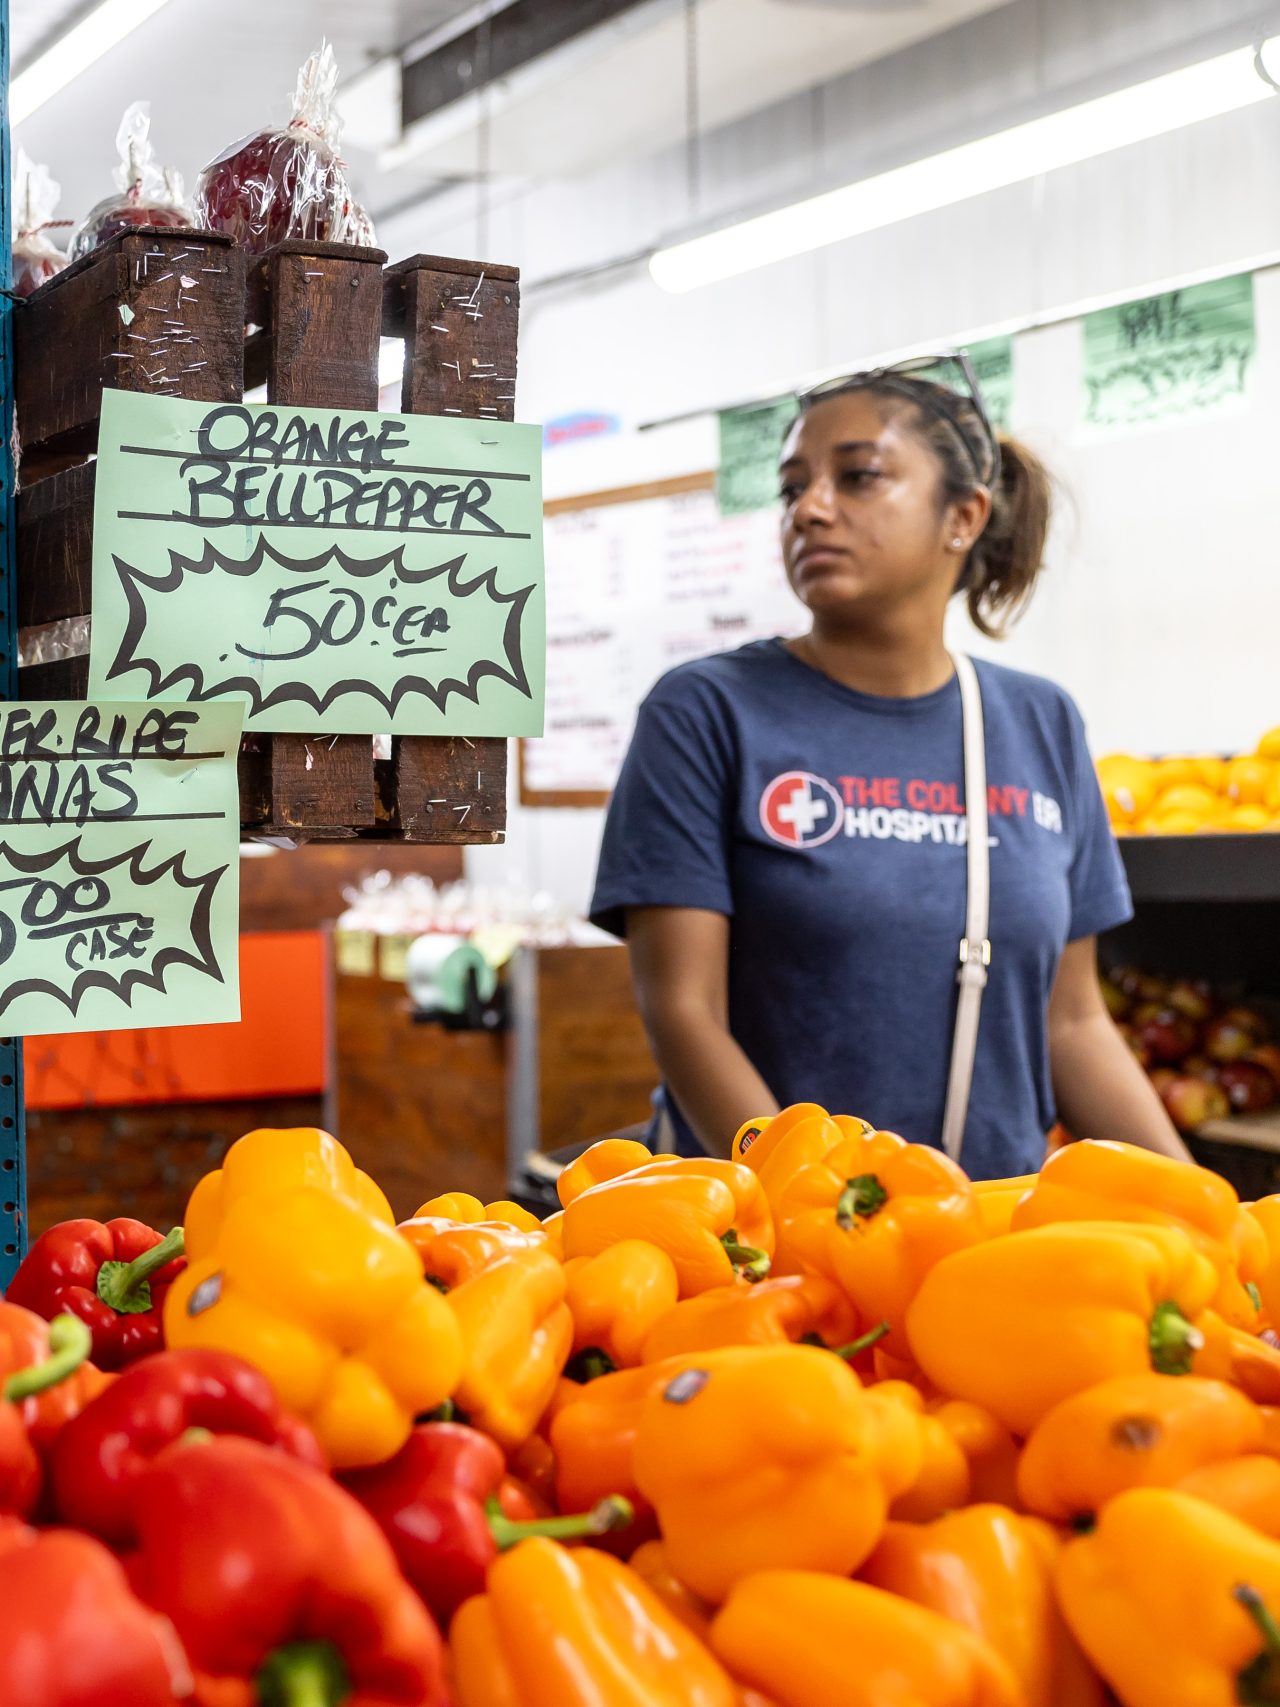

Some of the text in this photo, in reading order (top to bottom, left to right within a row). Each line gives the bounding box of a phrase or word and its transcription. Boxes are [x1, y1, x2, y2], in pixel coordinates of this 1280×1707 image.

[198, 406, 409, 475] ORANGE
[392, 606, 451, 656] EA
[838, 776, 902, 808] THE
[906, 779, 1030, 817] COLNY
[65, 923, 154, 972] CASE
